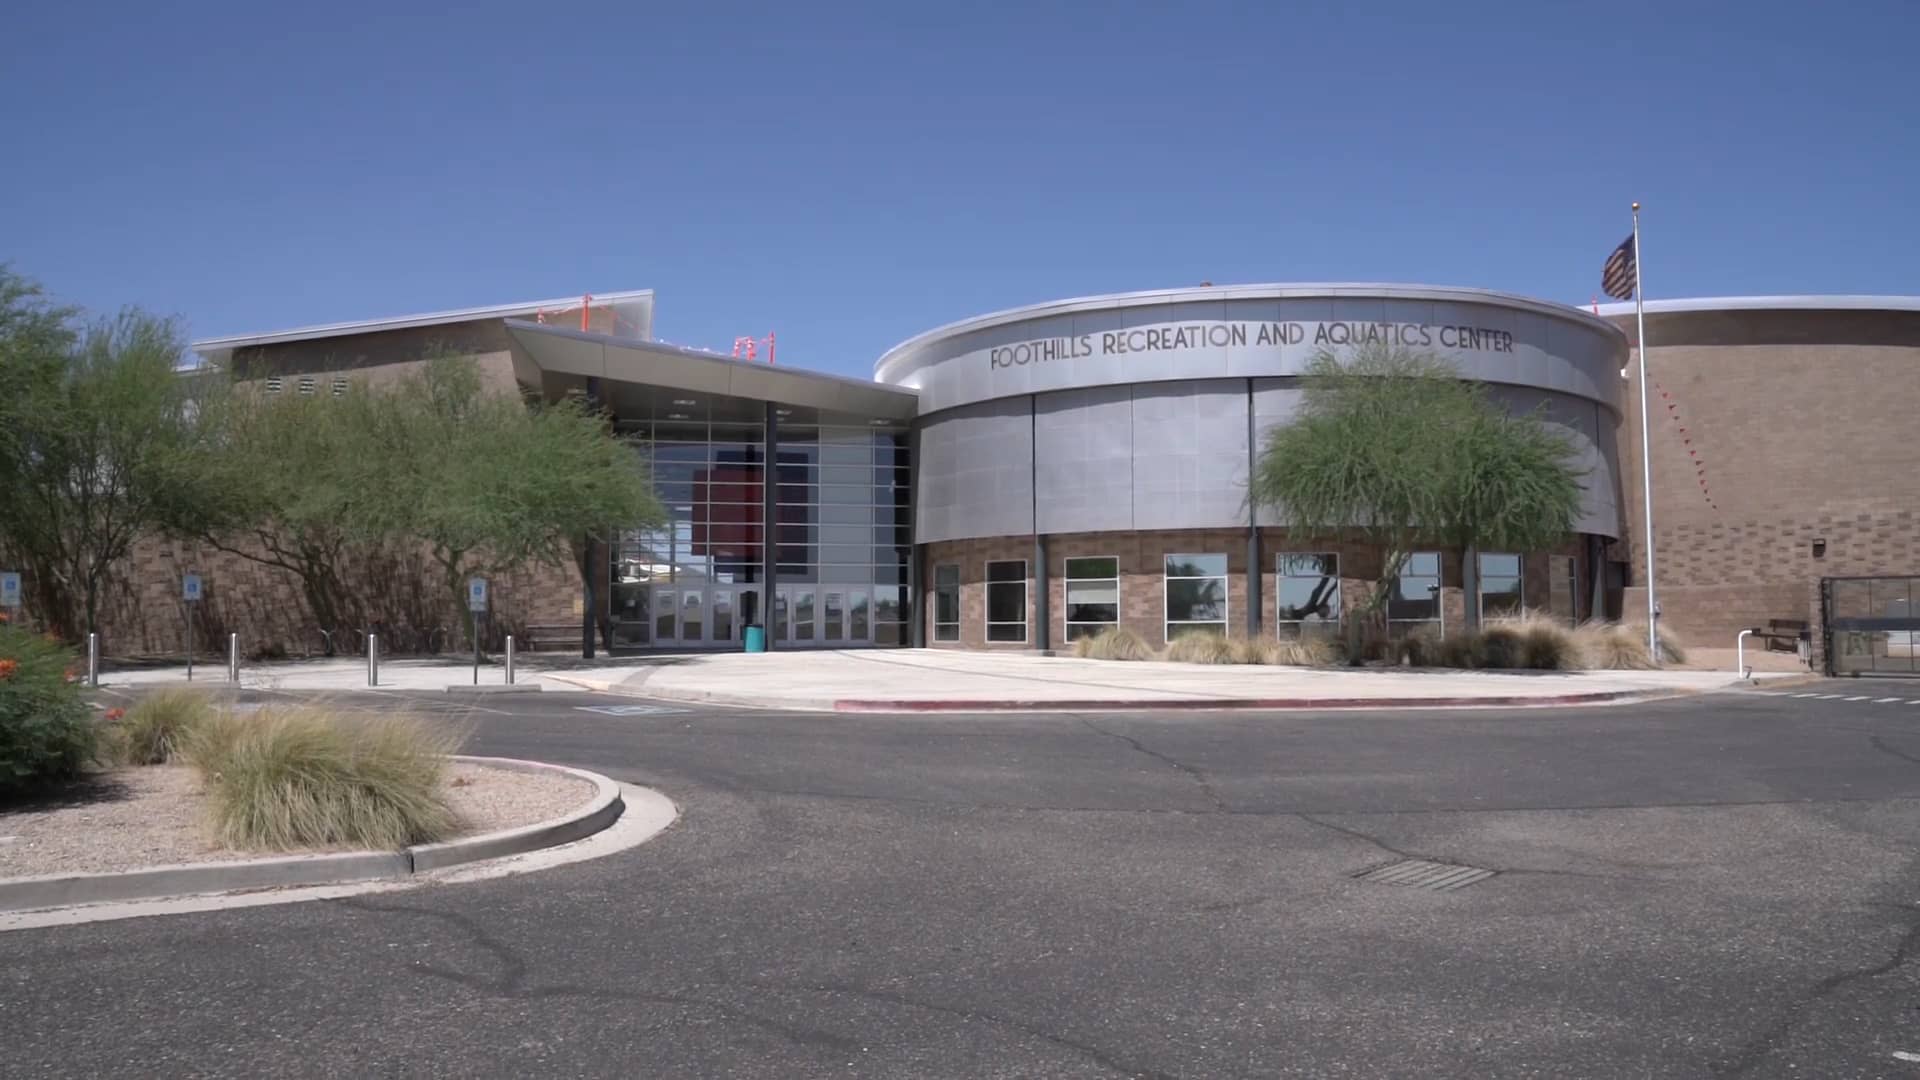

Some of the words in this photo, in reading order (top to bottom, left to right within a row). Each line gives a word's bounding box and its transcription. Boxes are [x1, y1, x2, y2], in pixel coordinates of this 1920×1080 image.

[991, 335, 1093, 370] FOOTHILLS
[1103, 323, 1247, 355] RECREATION
[1256, 322, 1305, 346] AND
[1314, 322, 1432, 347] AQUATICS
[1439, 325, 1513, 353] CENTER
